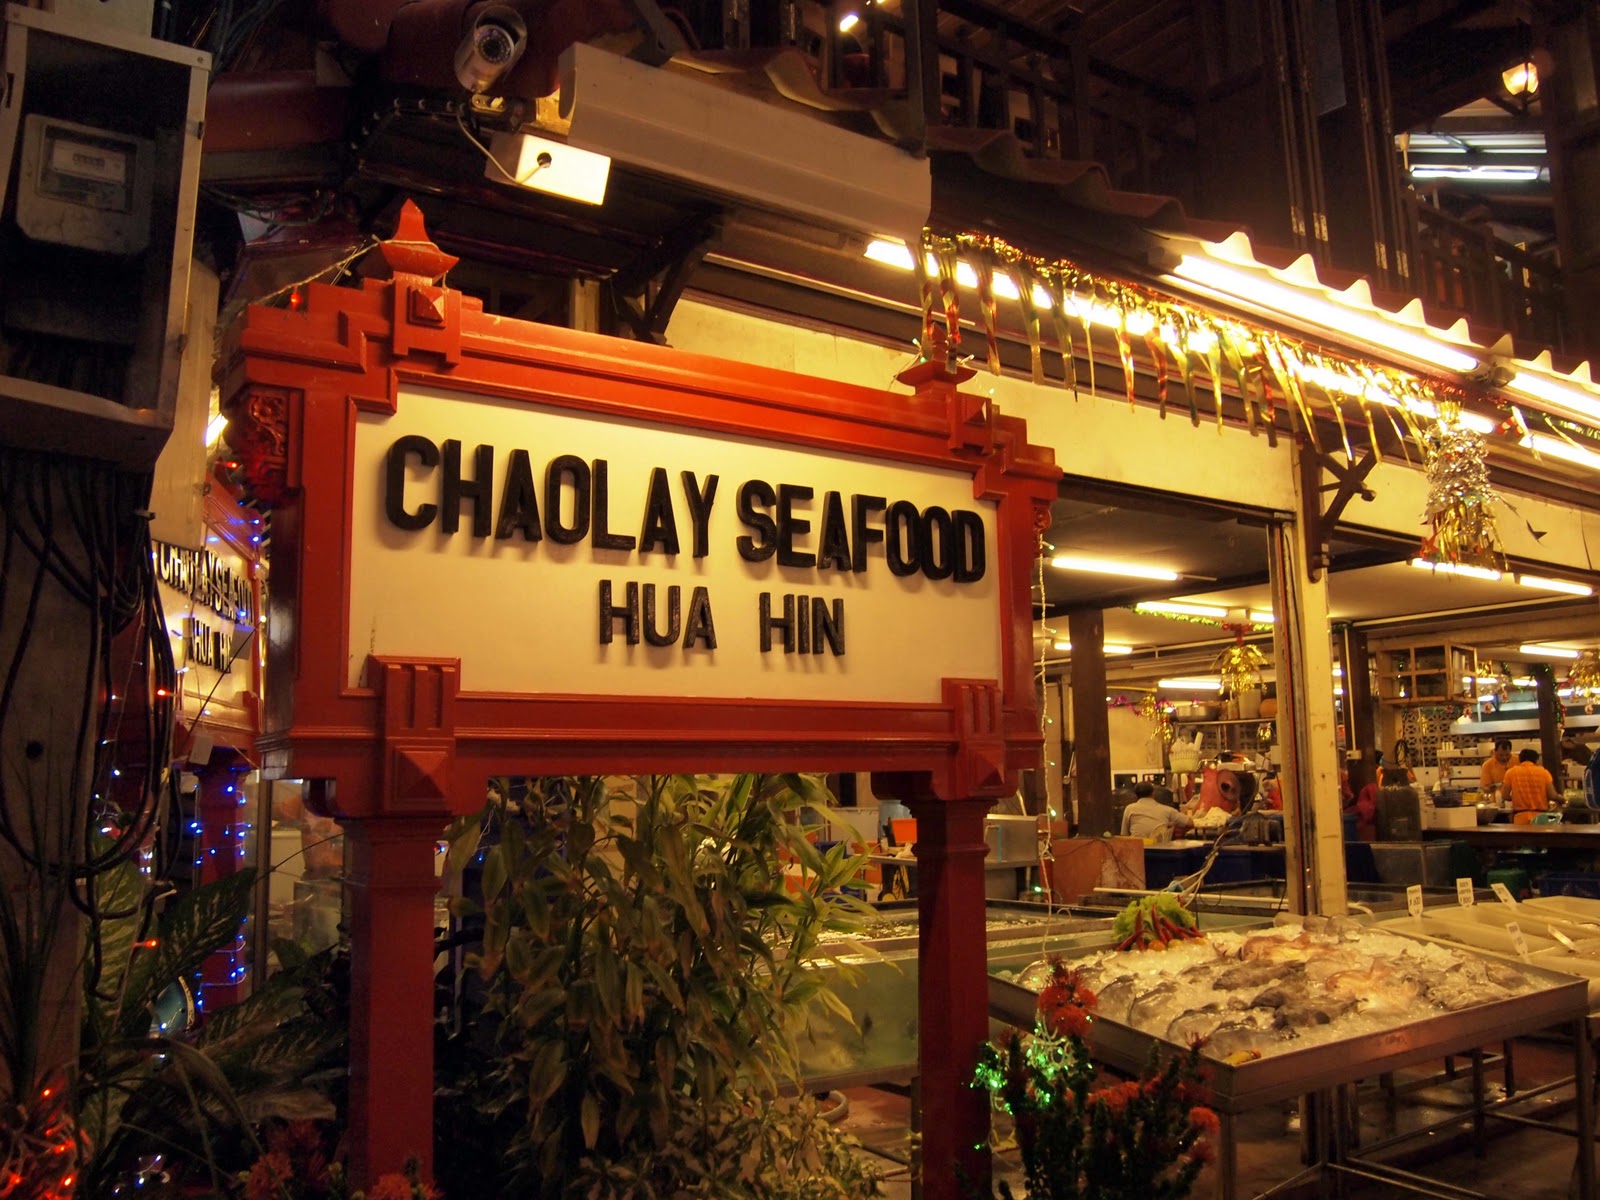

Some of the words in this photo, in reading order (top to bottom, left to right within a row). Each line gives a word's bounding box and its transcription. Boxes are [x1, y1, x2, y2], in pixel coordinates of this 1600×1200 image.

[386, 434, 719, 558] CHAOLAY
[736, 479, 985, 583] SEAFOOD
[188, 617, 212, 666] HUA
[600, 579, 717, 651] HUA
[759, 592, 846, 656] HIN
